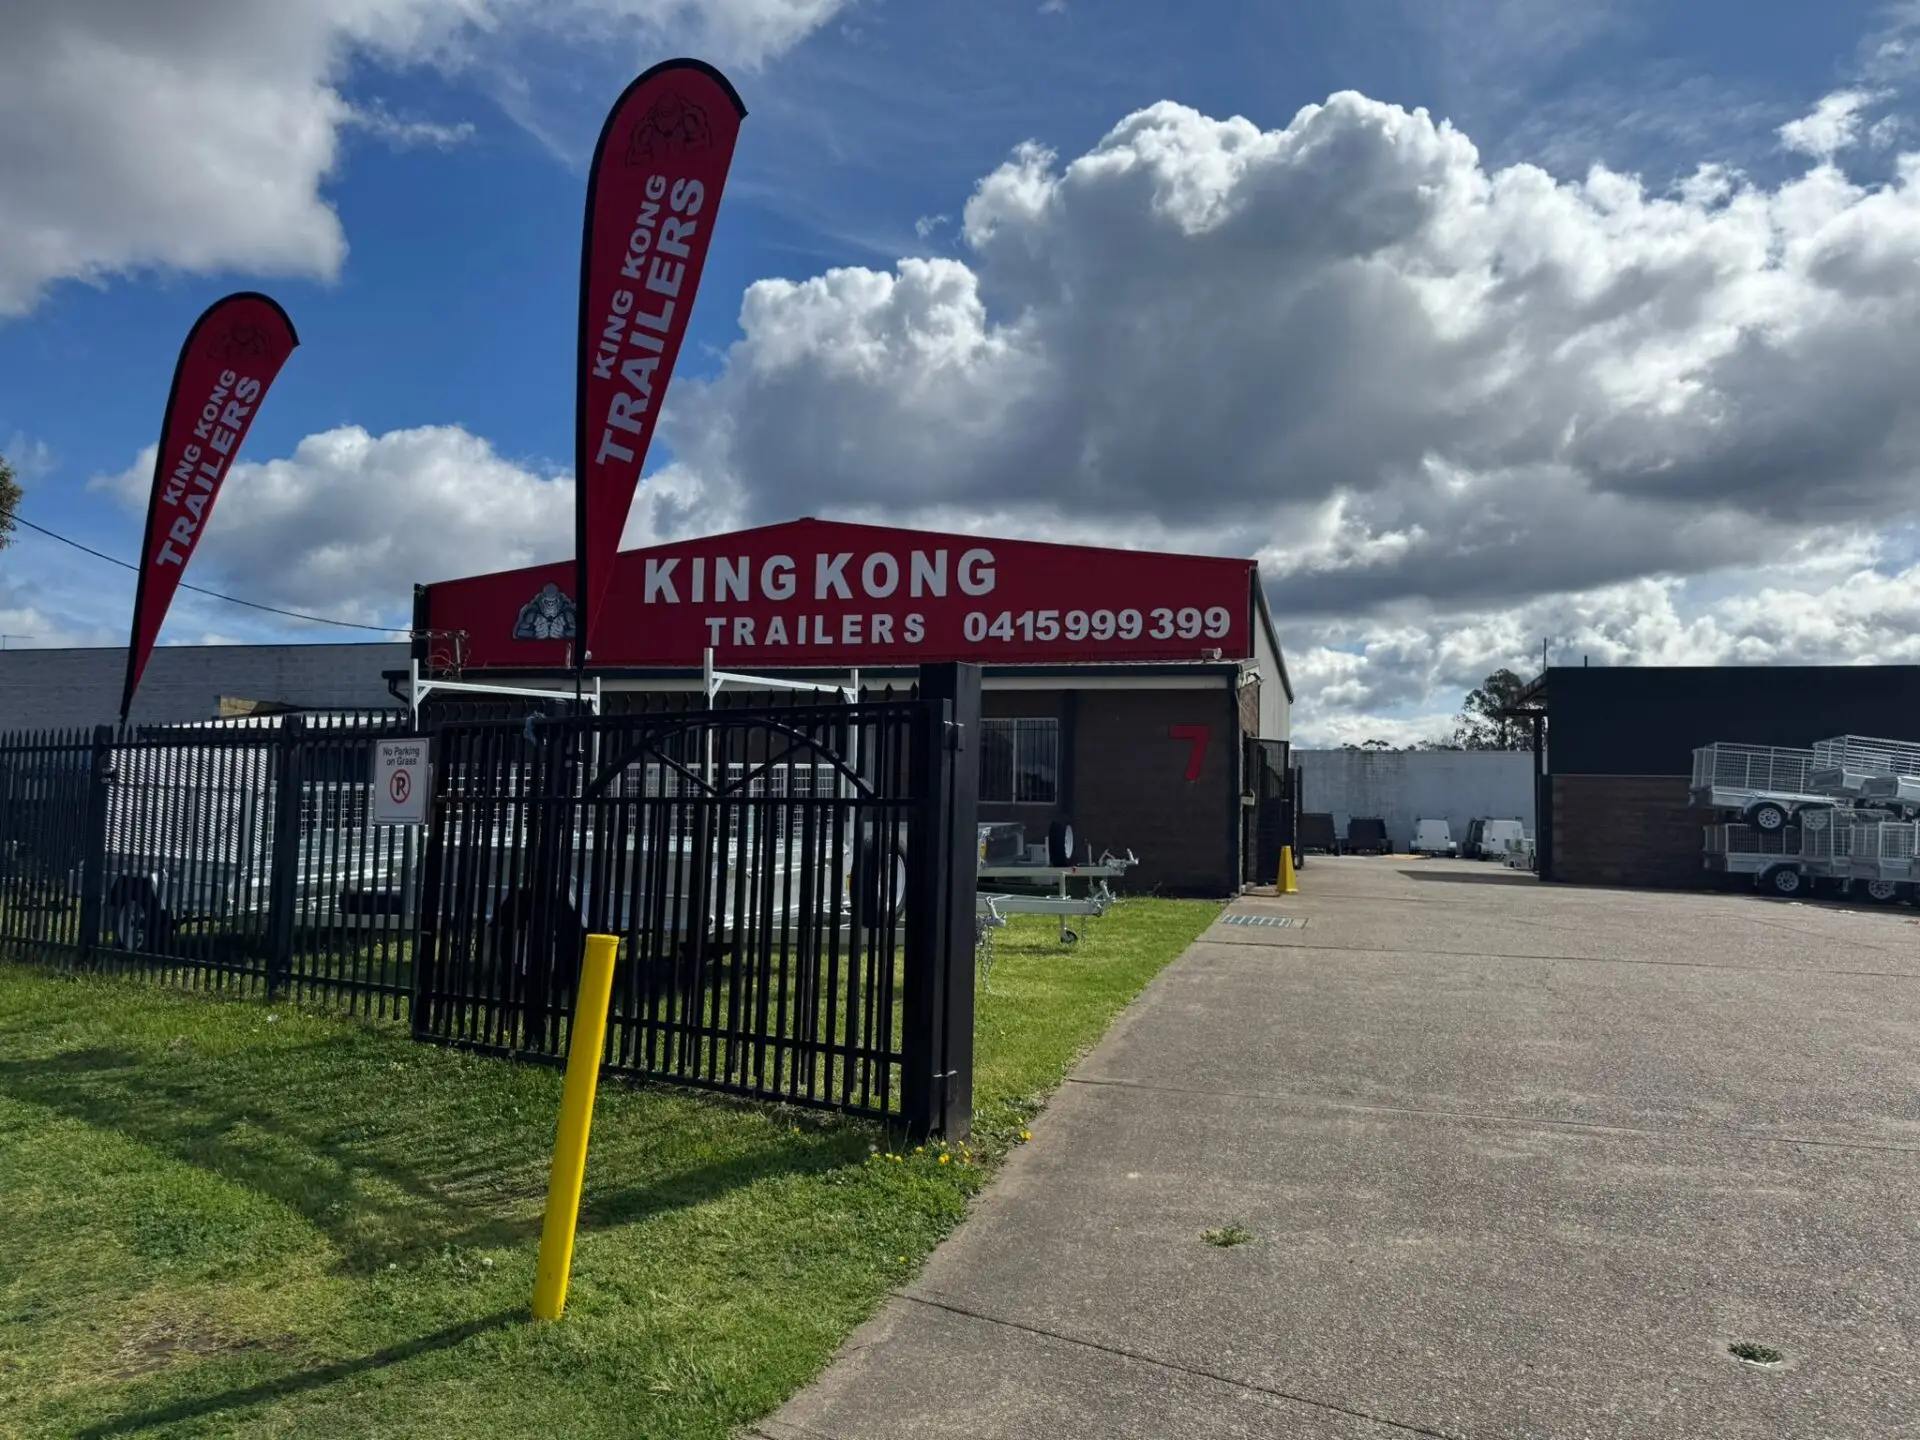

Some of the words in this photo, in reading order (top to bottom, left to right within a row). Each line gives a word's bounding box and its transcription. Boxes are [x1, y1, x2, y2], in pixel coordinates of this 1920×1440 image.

[592, 290, 633, 379] KING
[621, 174, 666, 278] KONG
[596, 178, 704, 464] TRAILERS
[162, 443, 200, 507] KING
[193, 369, 236, 440] KONG
[156, 376, 261, 567] TRAILERS
[644, 555, 796, 603] KING
[815, 549, 995, 600] KONG
[705, 613, 925, 646] TRAILERS
[1149, 606, 1230, 640] 399
[384, 747, 392, 756] No
[394, 746, 420, 757] Parking
[396, 757, 417, 766] Grass
[1169, 725, 1212, 781] 7
